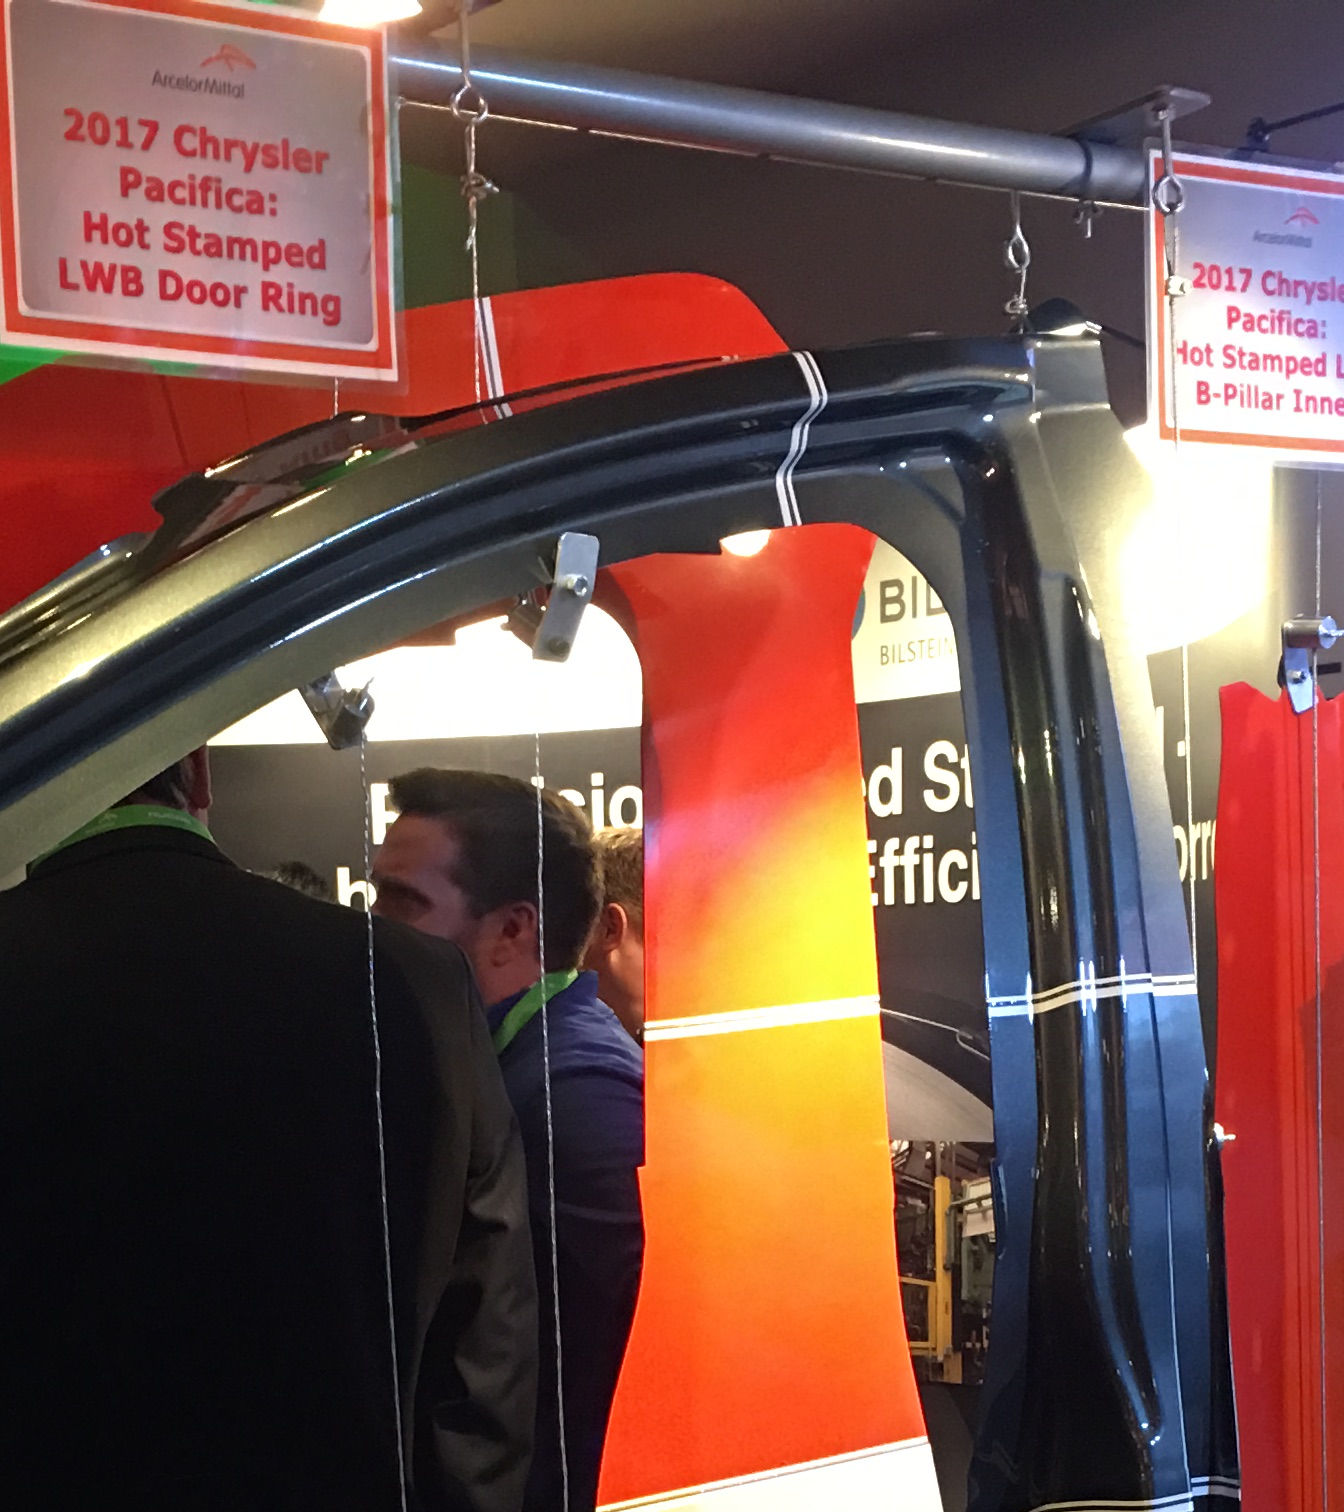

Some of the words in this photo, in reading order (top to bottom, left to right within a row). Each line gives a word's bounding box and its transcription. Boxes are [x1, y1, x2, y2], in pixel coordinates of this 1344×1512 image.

[151, 70, 244, 98] ArcelorMittal
[63, 108, 159, 150] 2017
[173, 124, 329, 174] Chrysler
[120, 166, 277, 216] Pacifica:
[84, 211, 150, 250] Hot
[162, 221, 326, 270] Stamped
[59, 258, 144, 297] LWB
[158, 270, 248, 307] Door
[261, 281, 342, 325] Ring
[1192, 263, 1252, 293] 2017
[1227, 306, 1327, 339] Pacifica:
[1223, 345, 1327, 379] Stamped
[1196, 380, 1284, 410] B-Pillar
